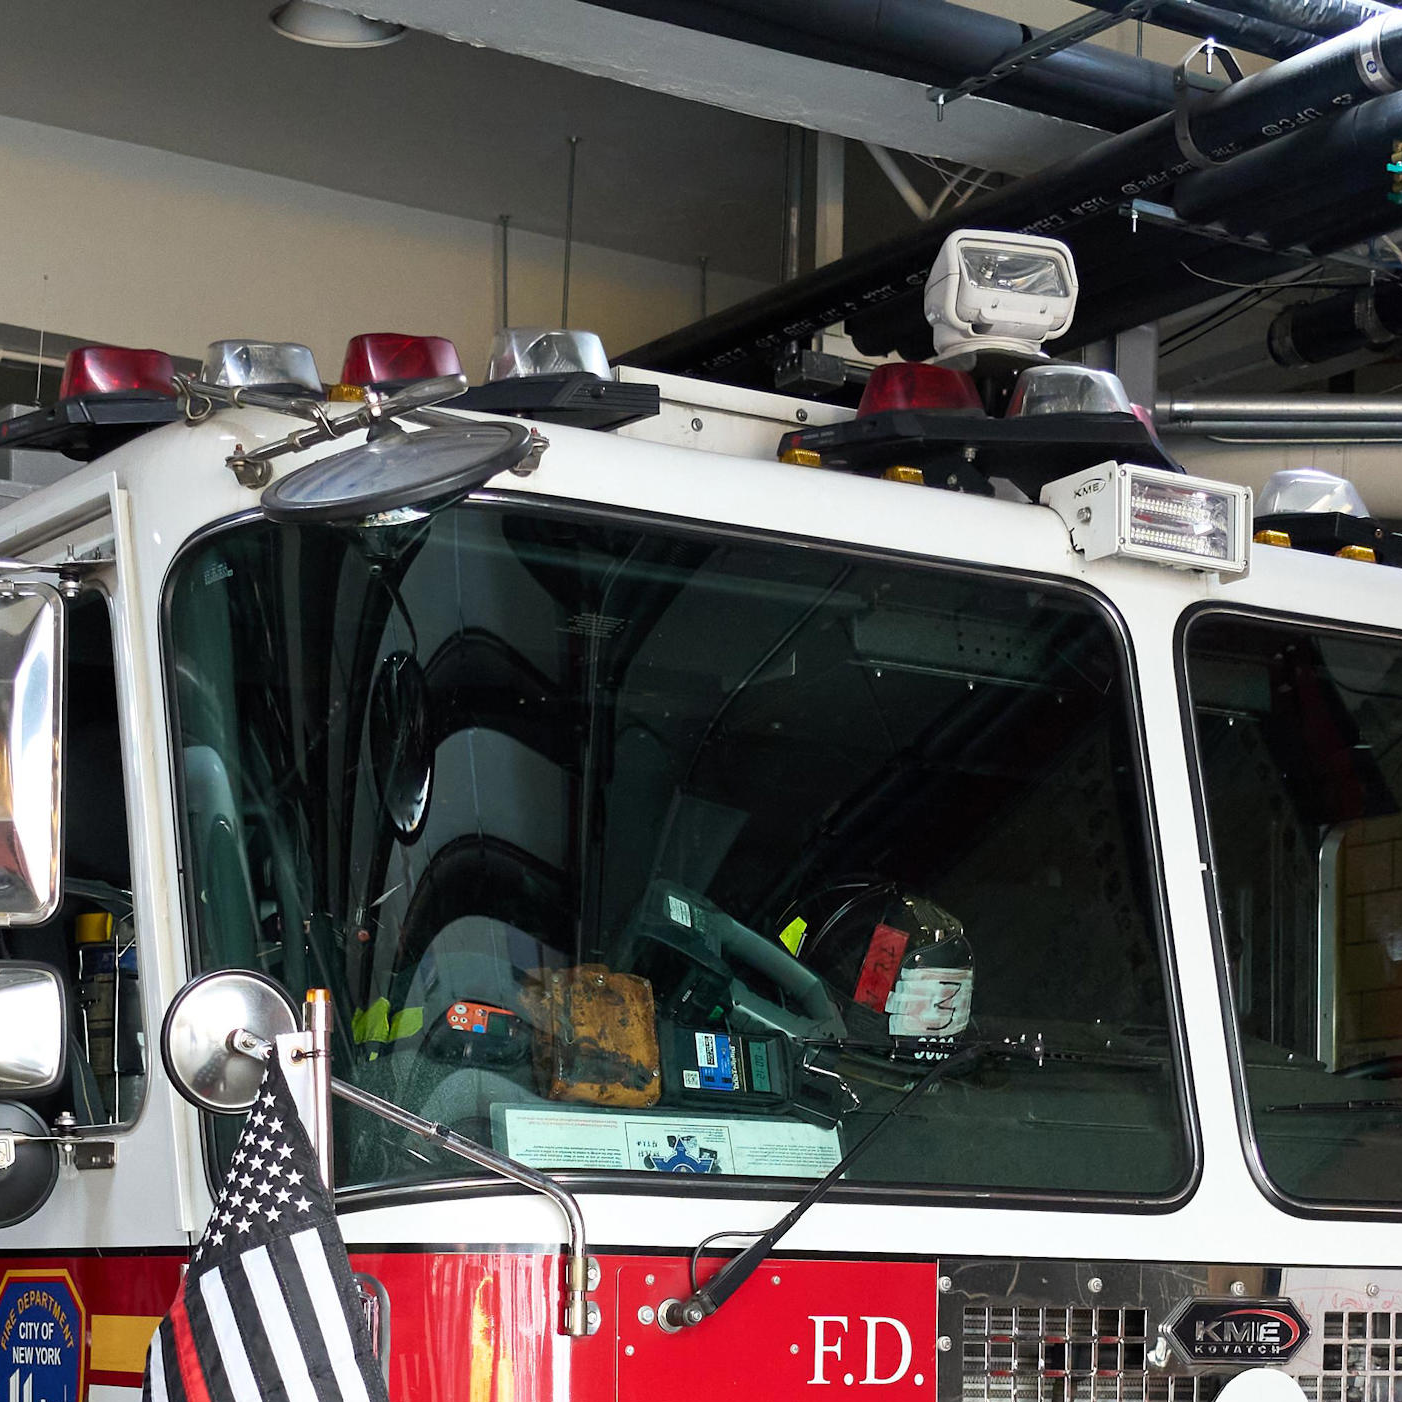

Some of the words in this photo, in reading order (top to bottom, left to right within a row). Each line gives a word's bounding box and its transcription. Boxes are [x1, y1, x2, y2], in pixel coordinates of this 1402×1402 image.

[1074, 482, 1100, 499] KME
[0, 1308, 17, 1351] FIRE
[17, 1289, 75, 1349] DEPARTMENT
[18, 1321, 40, 1340] CITY
[41, 1322, 55, 1340] OF
[1195, 1320, 1280, 1343] KME
[12, 1345, 34, 1365] NEW
[35, 1346, 62, 1365] YORK
[806, 1315, 925, 1386] F.D.
[1194, 1345, 1280, 1354] KOVATCH
